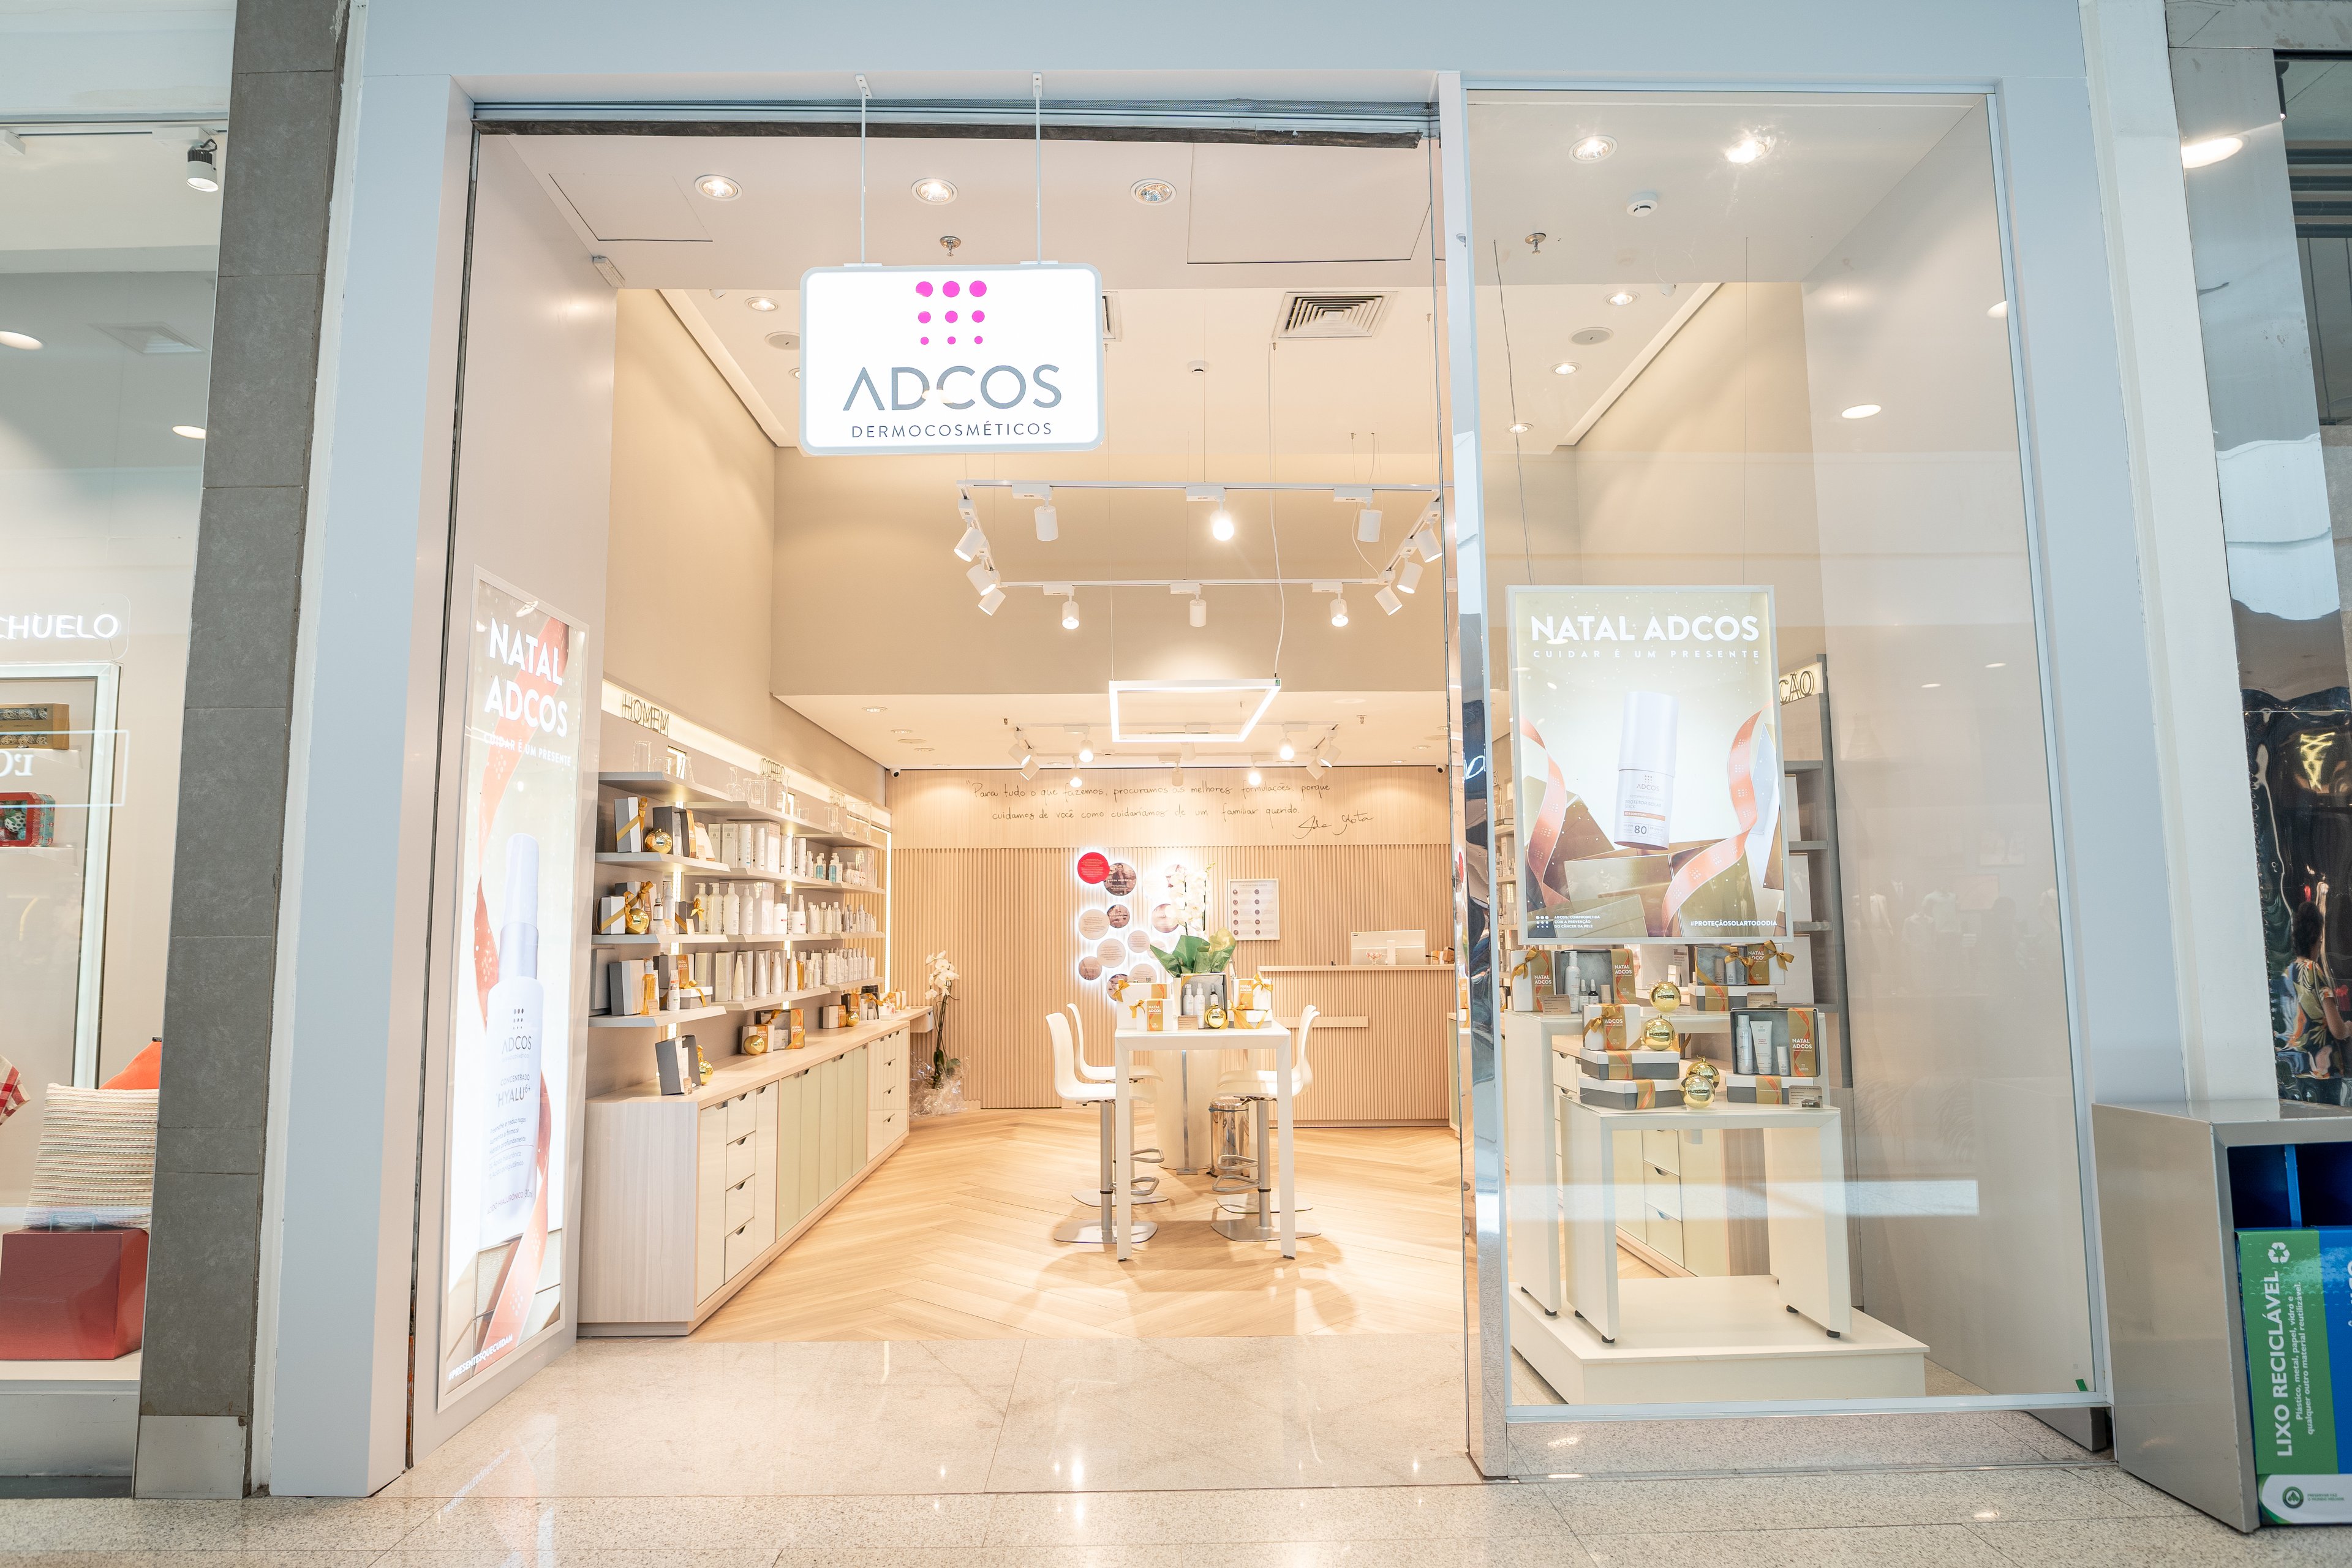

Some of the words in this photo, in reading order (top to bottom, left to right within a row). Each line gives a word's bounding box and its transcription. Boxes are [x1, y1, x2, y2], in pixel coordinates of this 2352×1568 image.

[843, 364, 1062, 410] ADCOS
[852, 420, 1052, 438] DERMOCOSMÉTICOS
[1531, 616, 1635, 641] NATAL
[1643, 616, 1760, 642] ADCOS
[489, 617, 563, 686] NATAL
[1533, 650, 1600, 658] CUIDAR
[1615, 648, 1620, 658] É
[1635, 650, 1656, 658] UM
[1671, 650, 1759, 658] PRESENTE
[484, 675, 568, 737] ADCOS
[622, 693, 669, 737] HOMEM
[518, 739, 522, 753] É
[525, 744, 537, 757] UM
[538, 747, 572, 766] PRESENTE
[1004, 783, 1026, 797] tudo
[1041, 790, 1058, 805] que
[1114, 787, 1169, 803] procuramos
[1191, 780, 1233, 794] melhores
[1301, 784, 1330, 801] porque
[992, 807, 1035, 820] cuidamos
[1039, 808, 1049, 819] de
[1056, 809, 1074, 818] você
[1111, 807, 1168, 817] cuidaríamos
[1175, 804, 1186, 818] de
[1221, 802, 1259, 823] familiar
[1634, 825, 1647, 834] 80
[1691, 919, 1777, 928] #PROTEÇÃOSOLARTODODIA
[502, 1035, 532, 1054] ADCOS
[500, 1074, 530, 1086] CONCENTRADO
[2262, 1271, 2288, 1398] RECICLÁVEL
[448, 1333, 513, 1382] #PRESENTESQUECUIDAM
[2299, 1333, 2309, 1369] material
[2291, 1355, 2300, 1382] metal,
[2305, 1397, 2315, 1435] qualquer
[2274, 1404, 2293, 1456] LIXO
